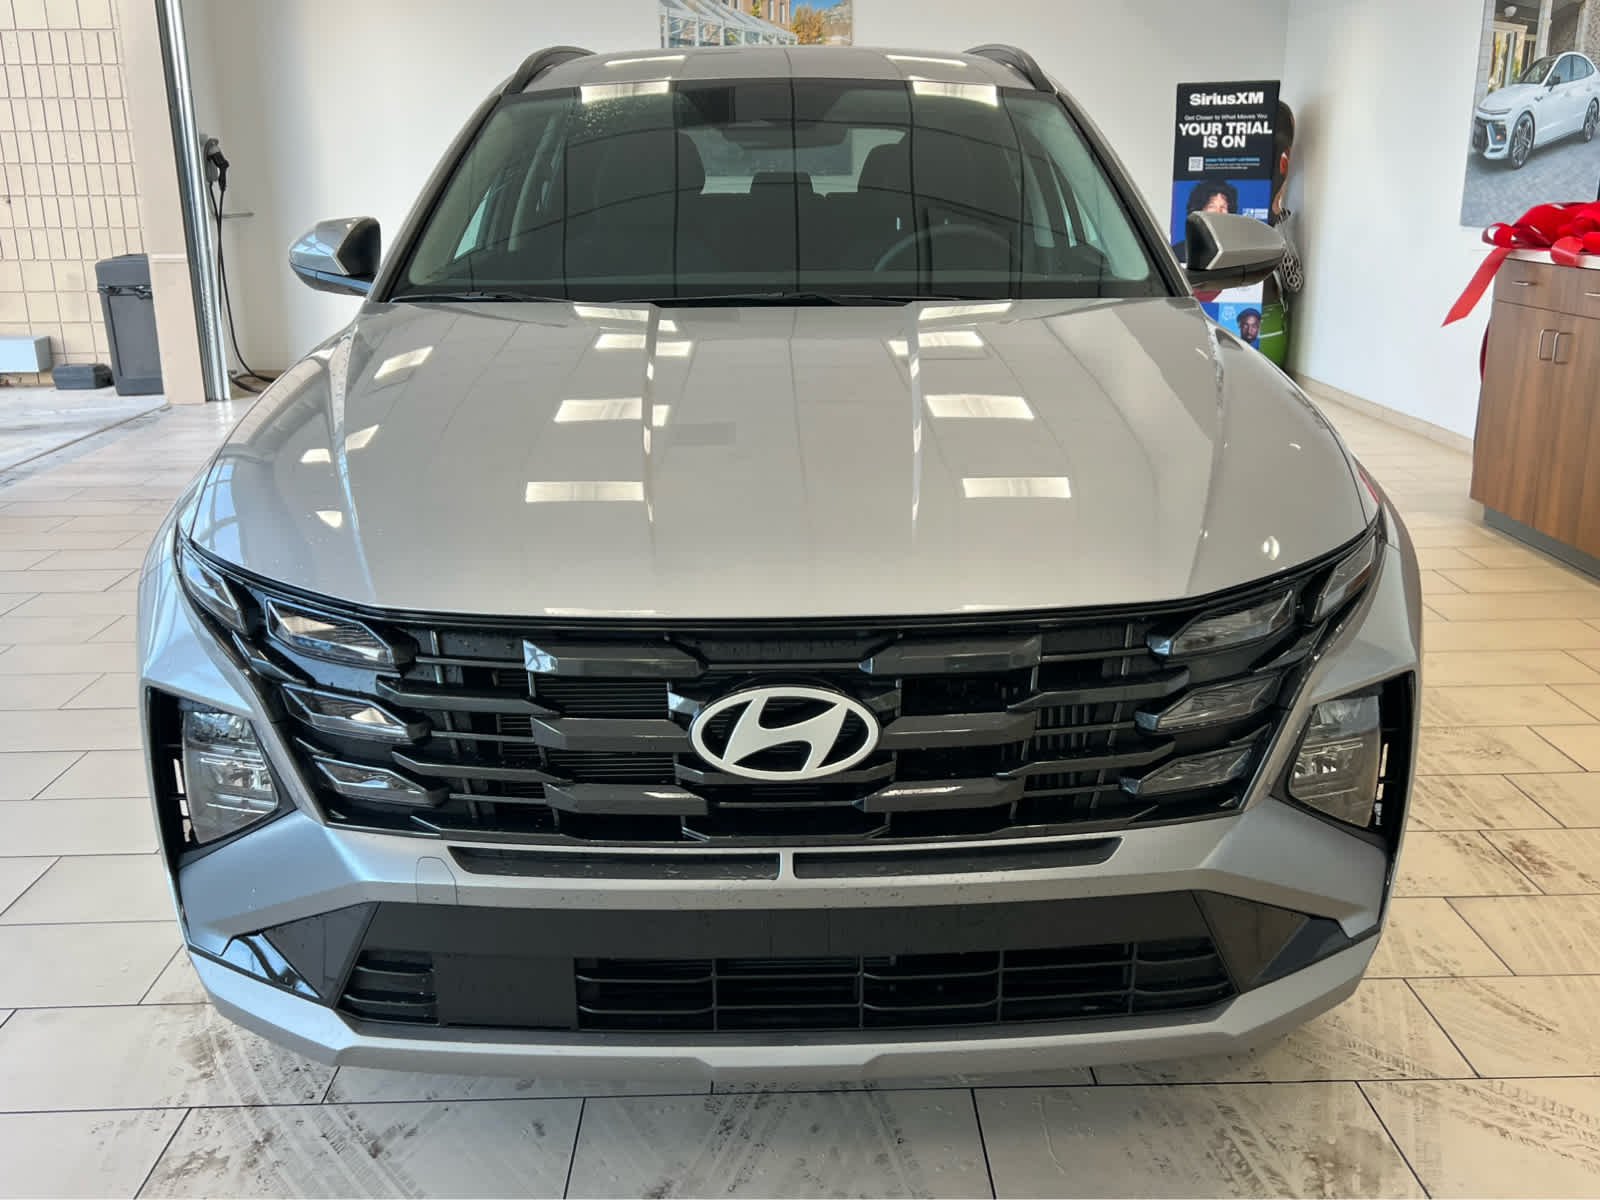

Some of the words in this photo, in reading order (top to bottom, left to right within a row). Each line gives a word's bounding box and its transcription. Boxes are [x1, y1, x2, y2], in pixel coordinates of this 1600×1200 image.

[1189, 91, 1264, 106] SiriusXM
[1179, 122, 1222, 136] YOUR
[1226, 121, 1273, 135] TRIAL
[1203, 135, 1218, 148] IS
[1221, 135, 1246, 148] ON
